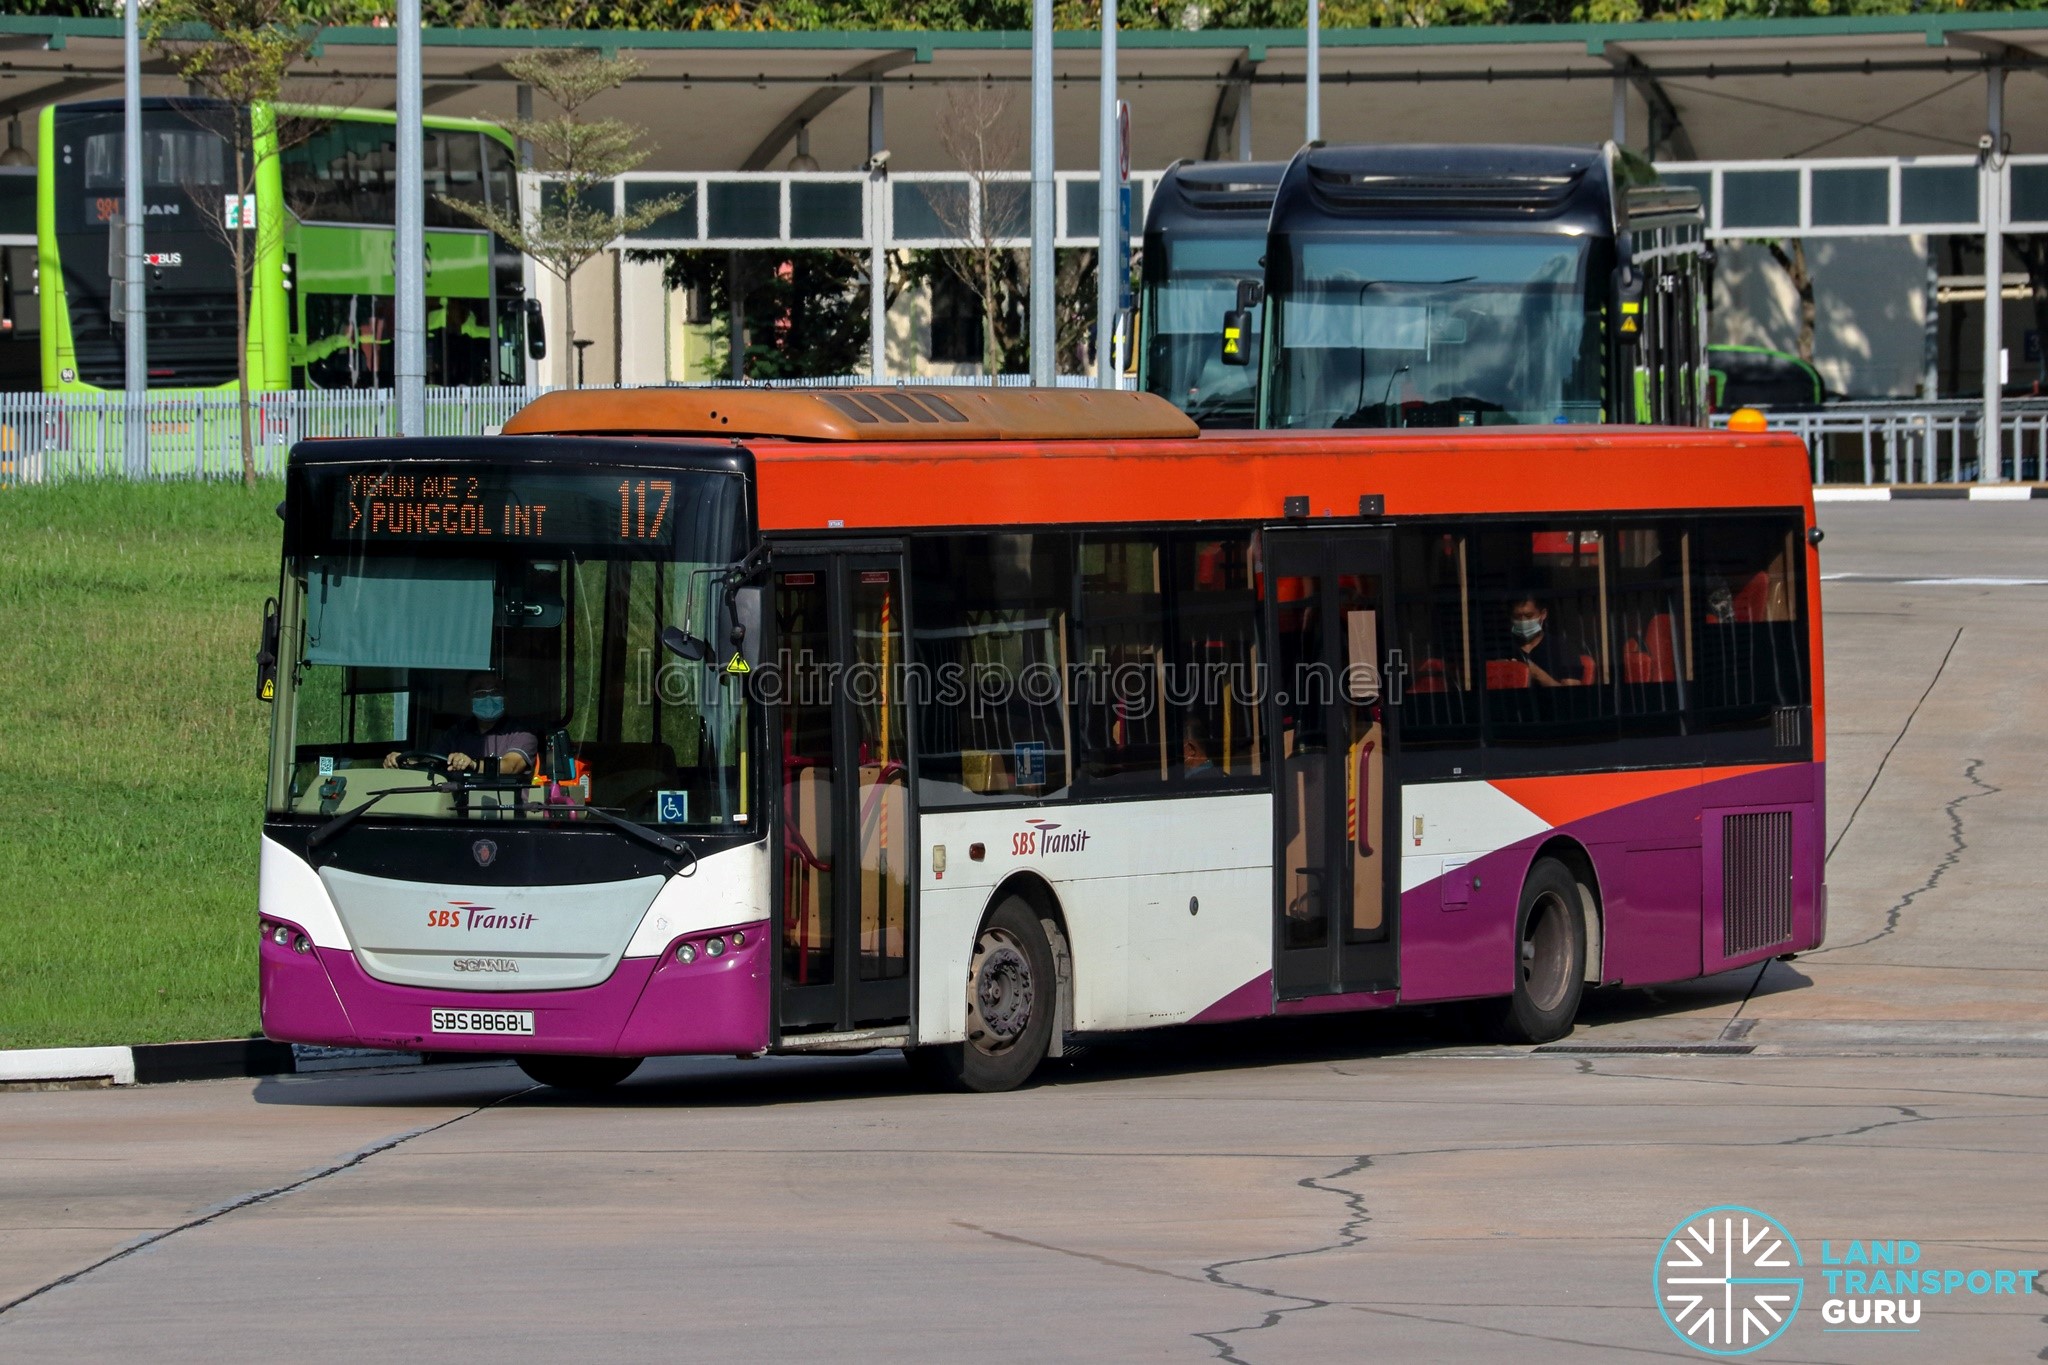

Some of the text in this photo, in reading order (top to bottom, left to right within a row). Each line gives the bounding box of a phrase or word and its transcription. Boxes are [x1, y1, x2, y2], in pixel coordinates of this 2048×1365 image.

[423, 476, 458, 498] AVE
[467, 477, 478, 498] 2
[373, 502, 547, 536] PUNGGOL INT
[618, 480, 672, 538] 117
[1011, 823, 1091, 859] SBS Transit
[427, 906, 539, 931] SBS Transit
[453, 958, 520, 973] SCANIA
